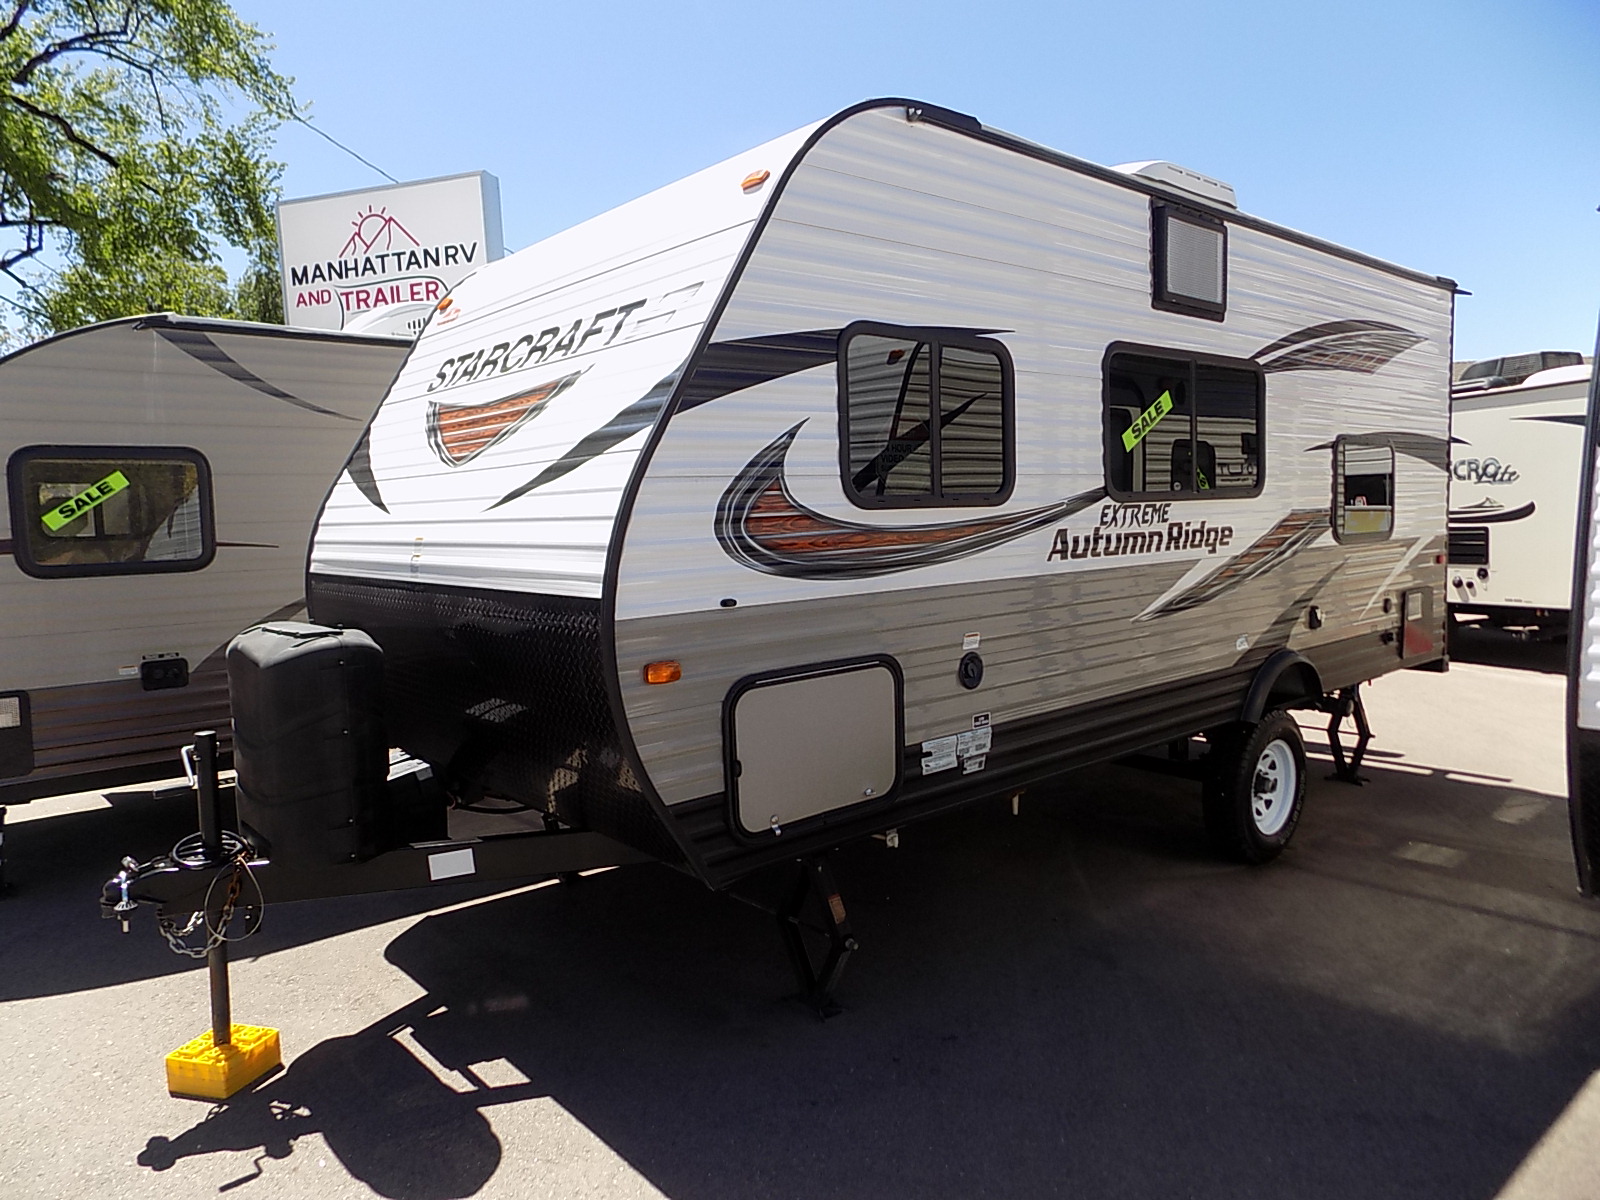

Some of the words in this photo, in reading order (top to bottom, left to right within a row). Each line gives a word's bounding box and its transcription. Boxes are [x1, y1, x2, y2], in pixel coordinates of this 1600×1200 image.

[296, 288, 332, 308] AND
[340, 280, 440, 311] TRAILER
[427, 298, 648, 393] STARCRAFT
[1131, 400, 1165, 440] SALE
[58, 481, 115, 519] SALE
[1099, 502, 1172, 528] EXTREME
